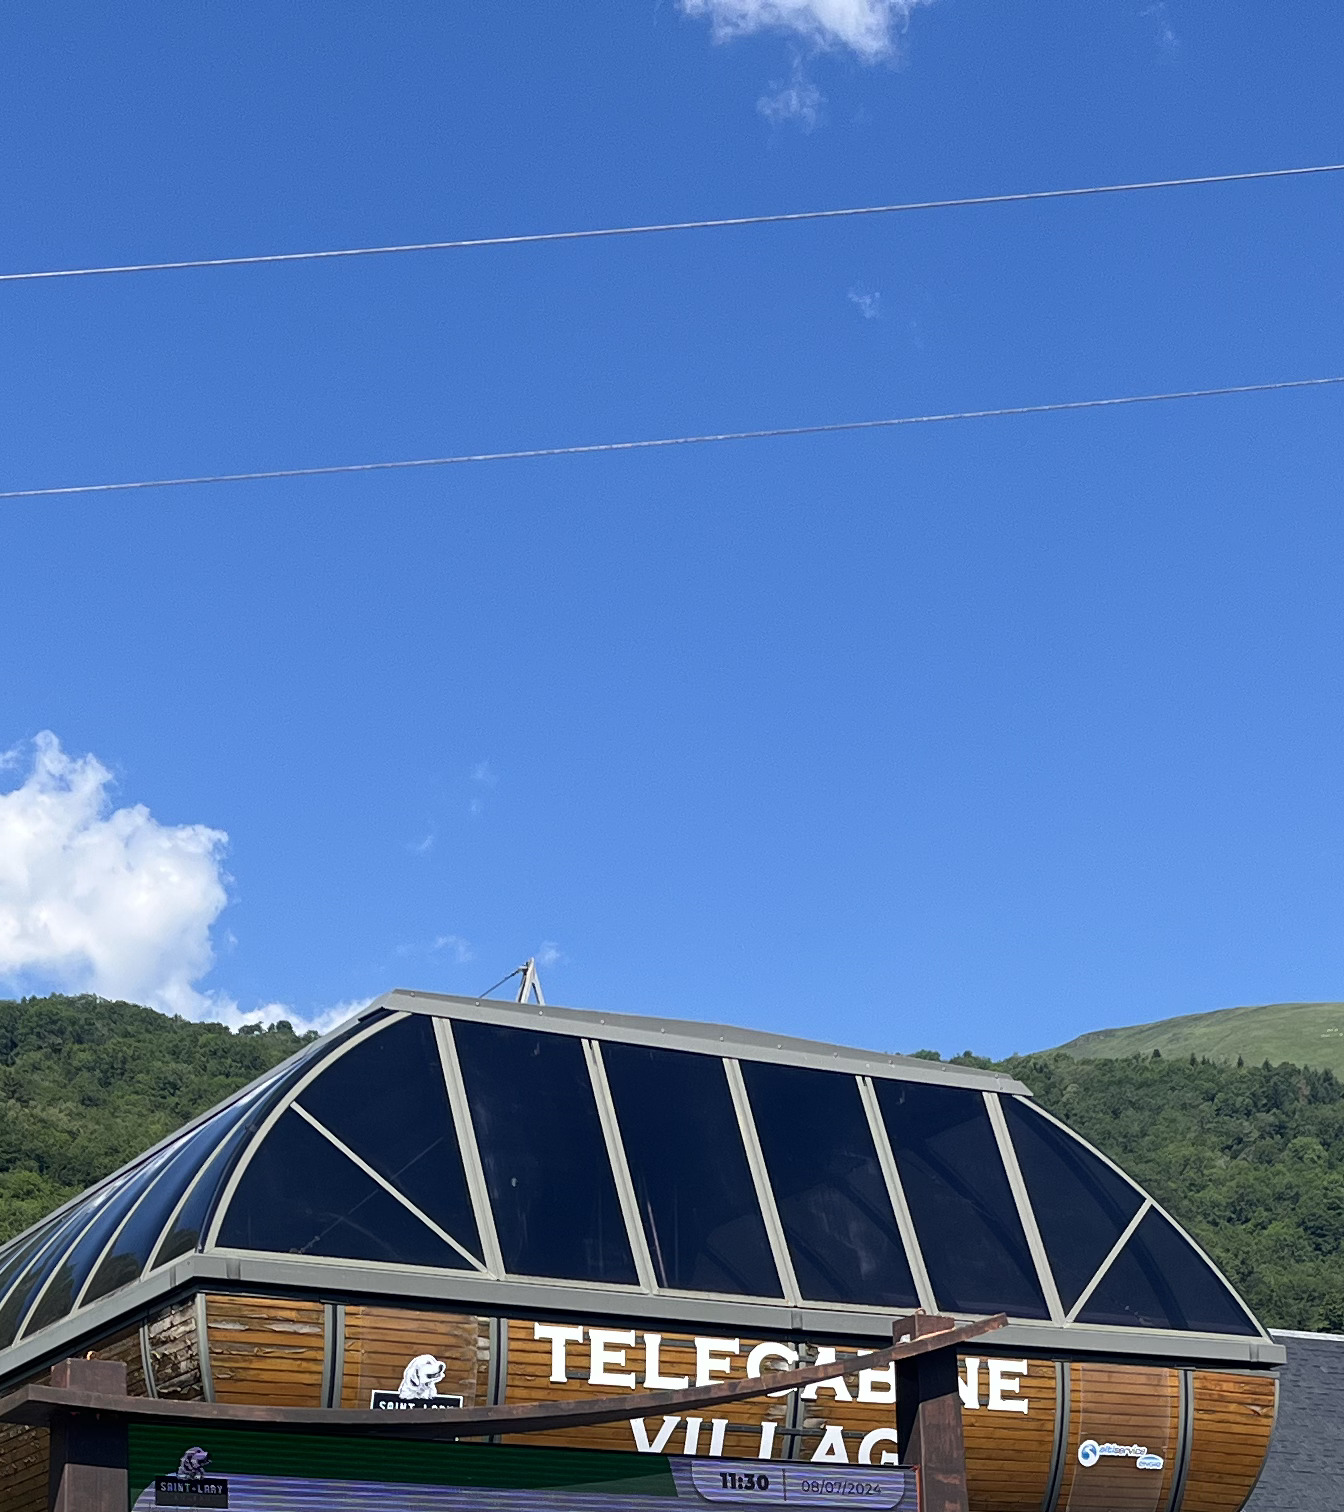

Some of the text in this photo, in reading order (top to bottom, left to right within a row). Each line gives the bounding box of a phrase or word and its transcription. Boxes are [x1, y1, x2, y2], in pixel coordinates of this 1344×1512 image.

[534, 1321, 1029, 1415] TELECABNE
[719, 1472, 770, 1491] 11:30
[801, 1479, 882, 1496] 08/07/2024
